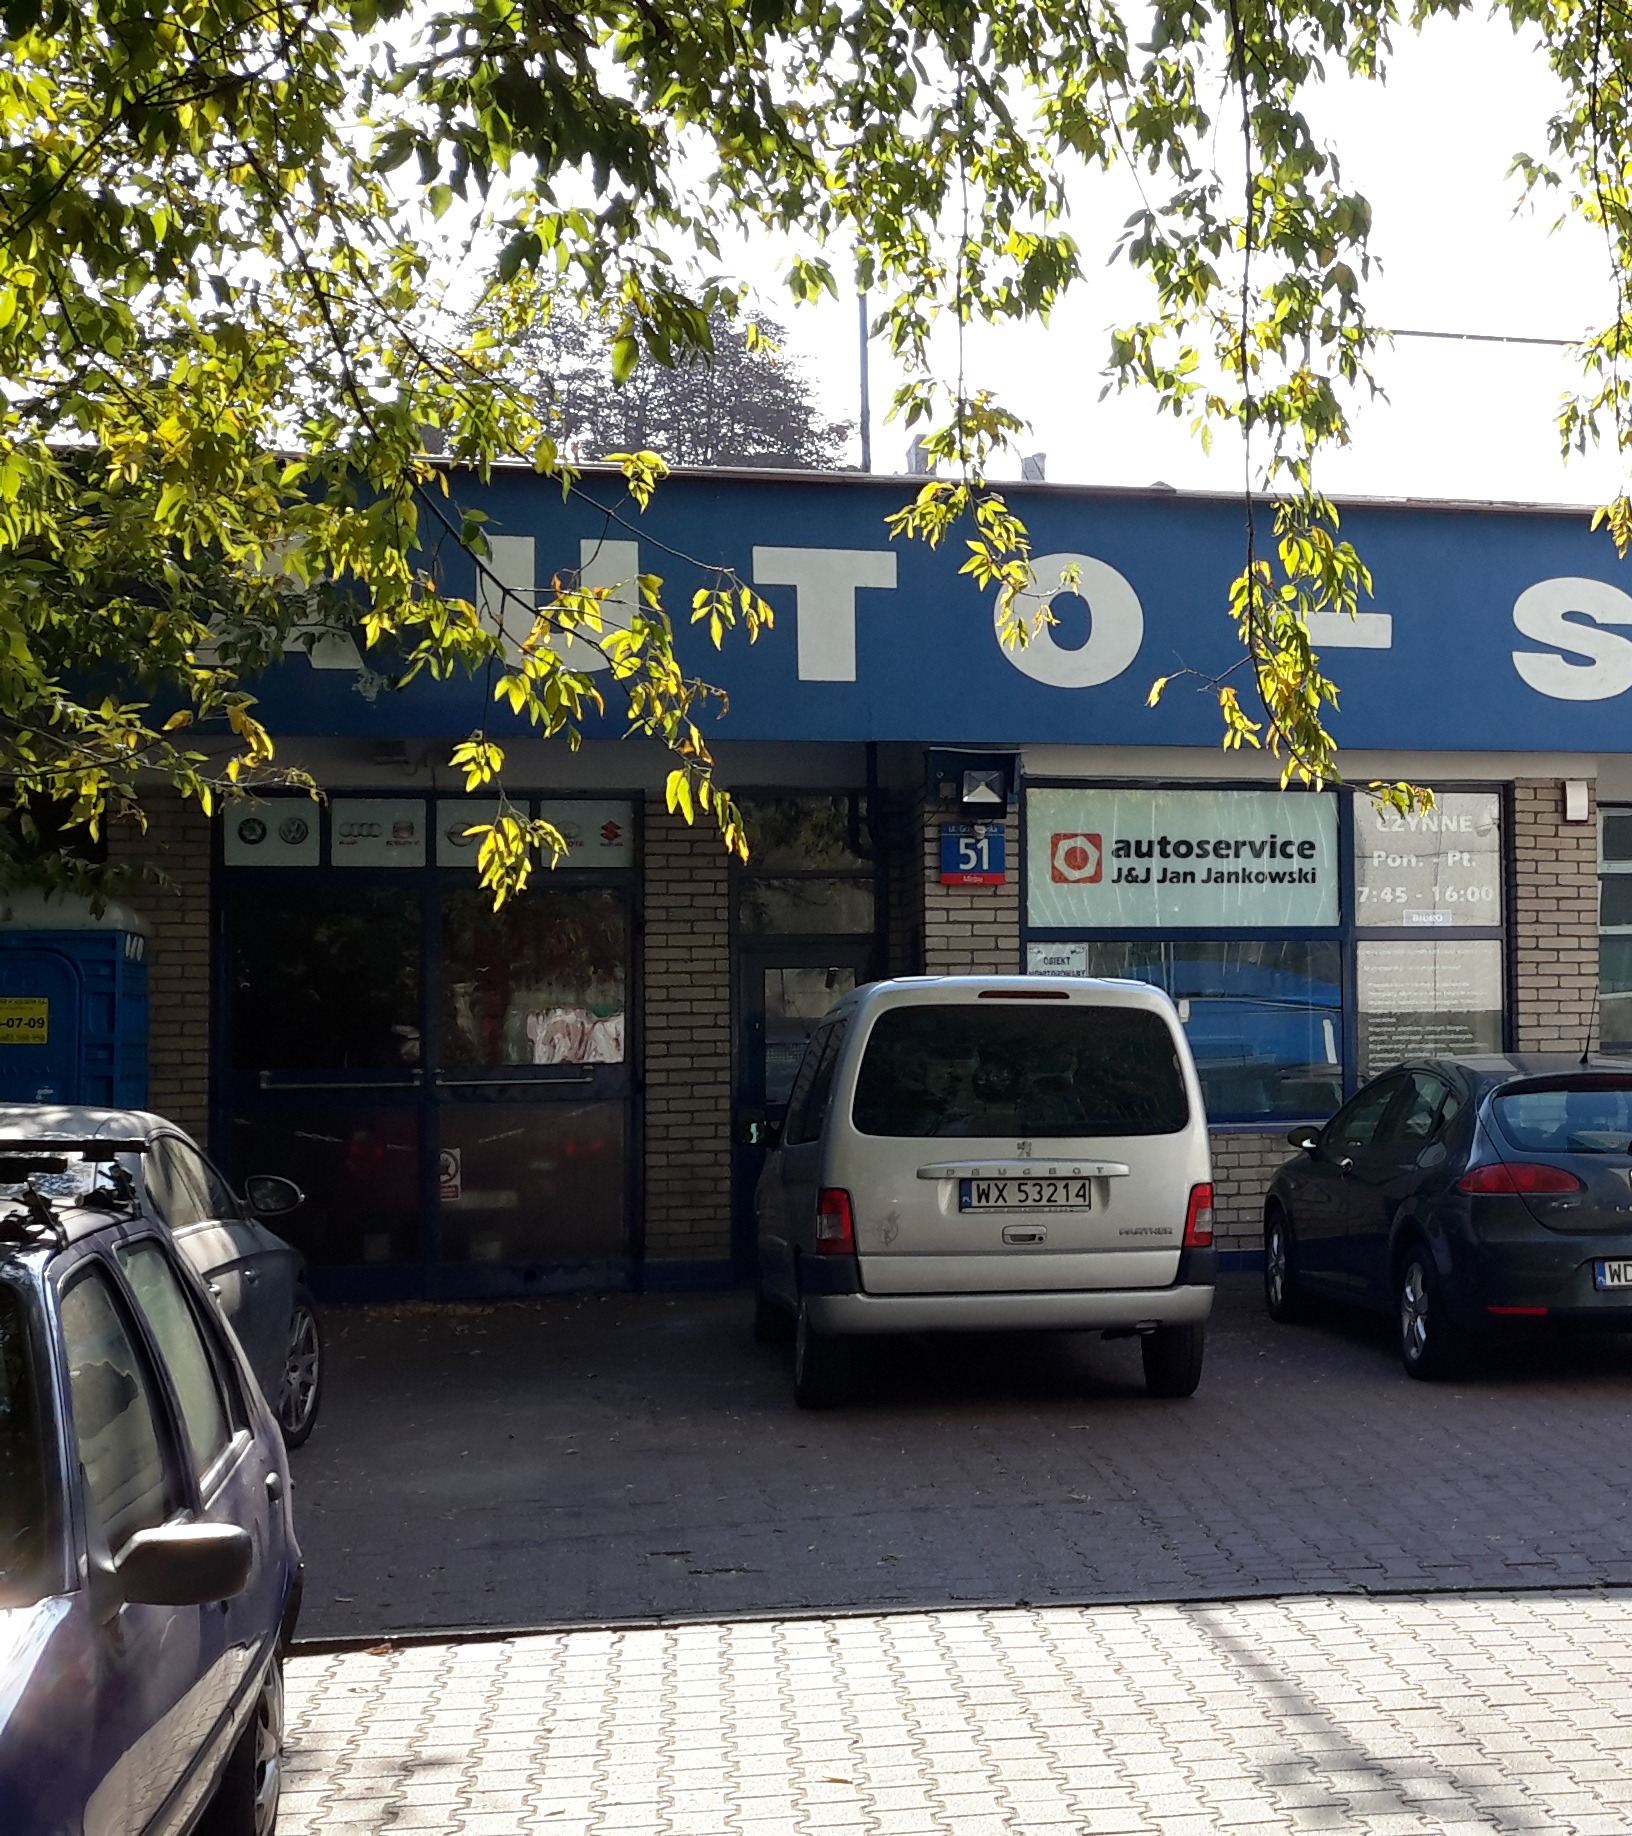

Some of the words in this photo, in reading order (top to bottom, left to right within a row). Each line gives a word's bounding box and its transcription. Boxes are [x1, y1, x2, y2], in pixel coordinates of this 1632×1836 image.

[1375, 815, 1473, 832] CZYNNE
[959, 837, 989, 870] 51
[1111, 834, 1316, 859] autoservice
[1372, 850, 1424, 867] Pon.
[1447, 850, 1476, 867] Pt.
[1111, 867, 1151, 884] J&J
[1157, 867, 1196, 884] Jan
[1201, 867, 1317, 884] Jankowski
[1357, 886, 1408, 903] 7:45
[1431, 886, 1494, 902] 16:00
[945, 1166, 1104, 1176] PEUGEOT
[976, 1183, 1008, 1204] WX
[1017, 1182, 1087, 1204] 53214
